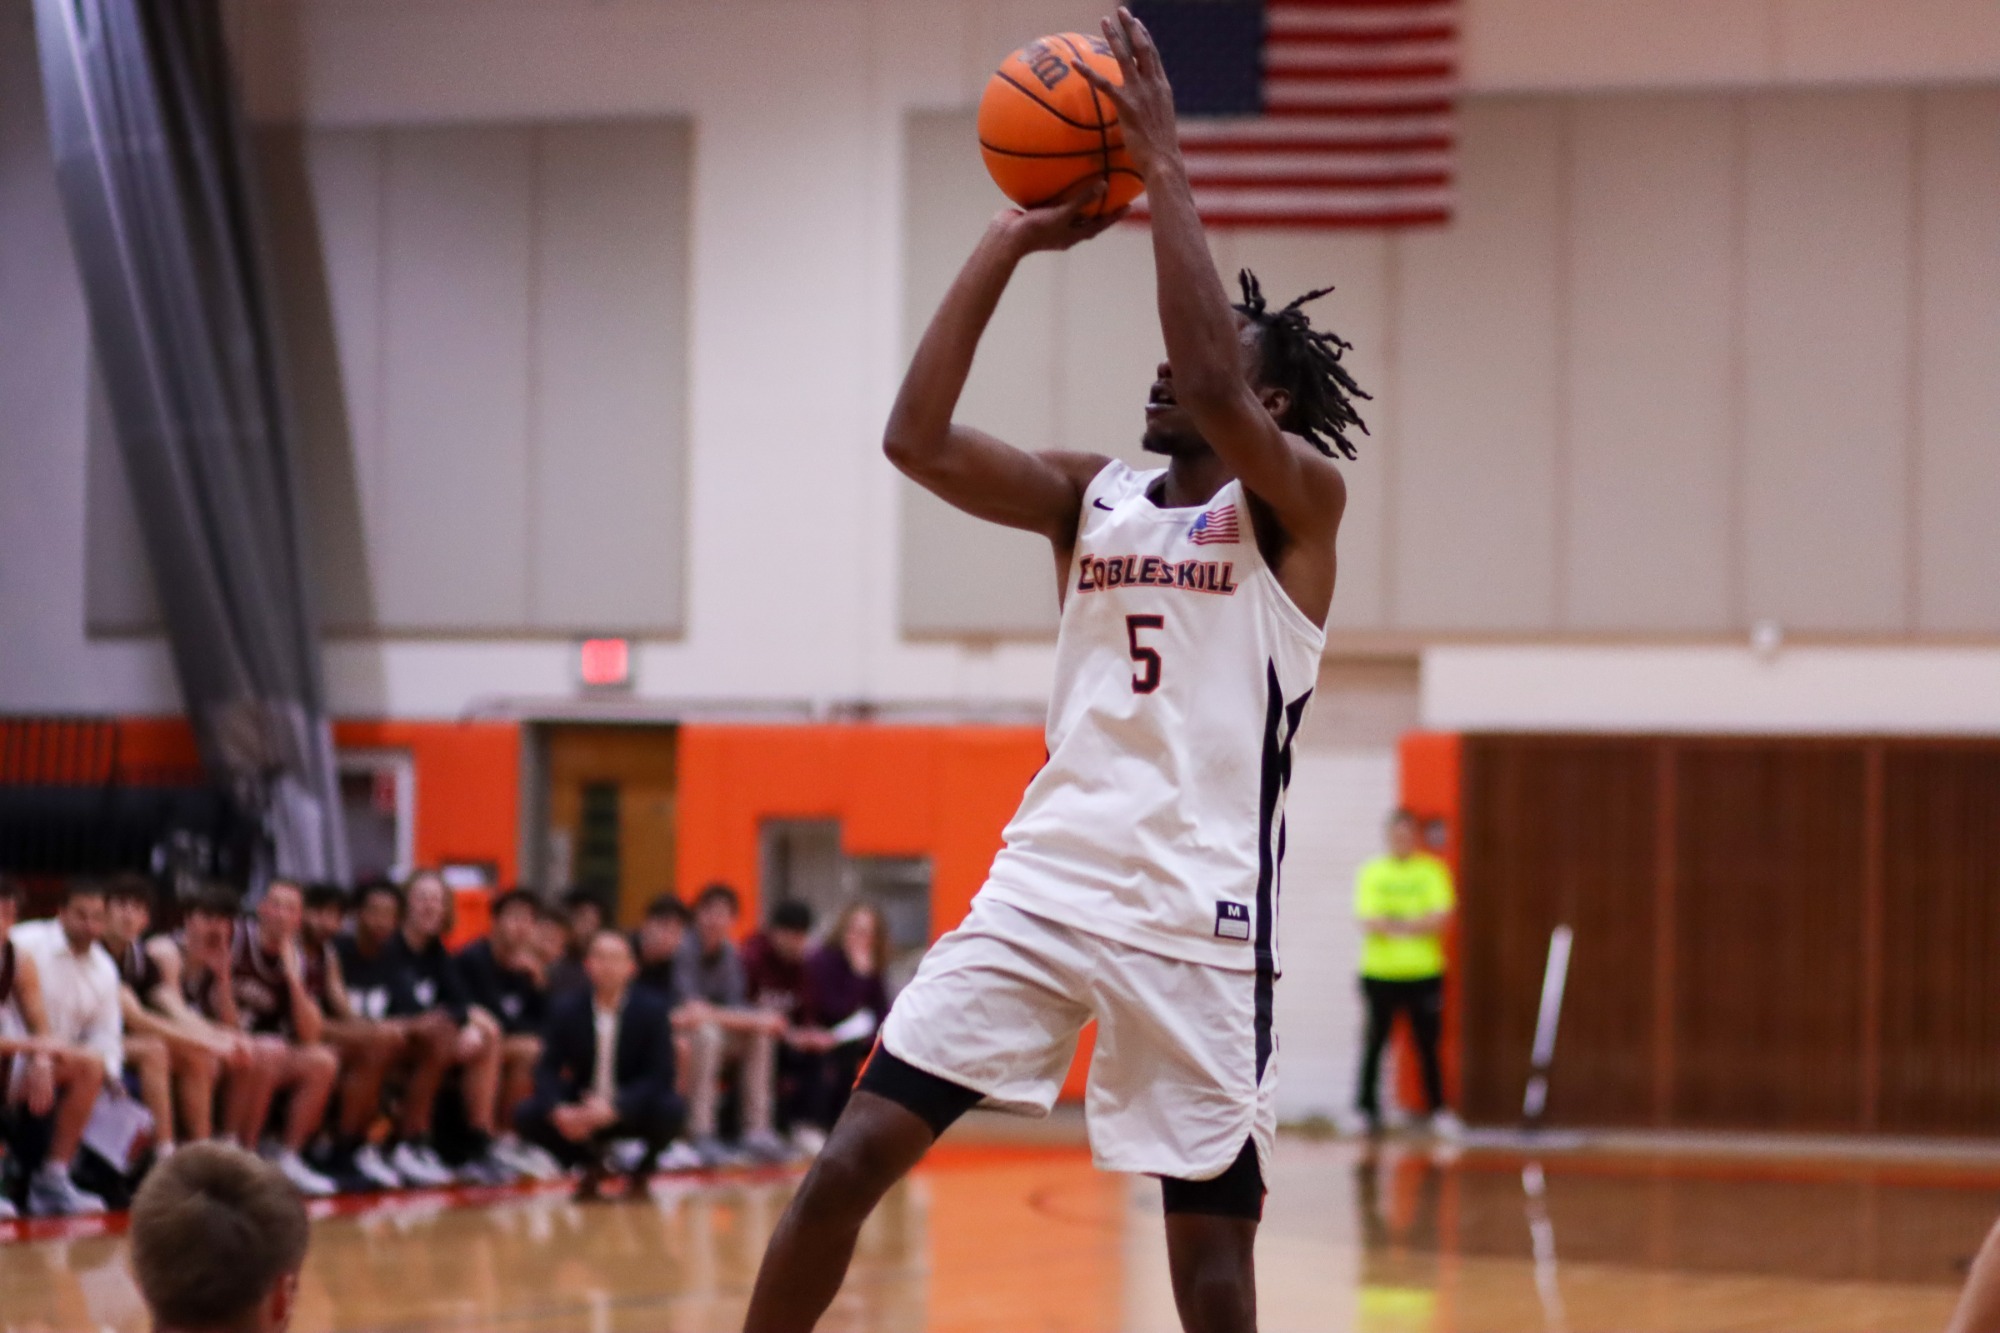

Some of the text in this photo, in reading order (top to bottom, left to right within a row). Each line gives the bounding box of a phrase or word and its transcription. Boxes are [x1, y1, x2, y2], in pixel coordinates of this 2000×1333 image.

[1077, 554, 1238, 595] COBLESKILL
[1126, 614, 1164, 694] 5
[1227, 904, 1241, 918] M
